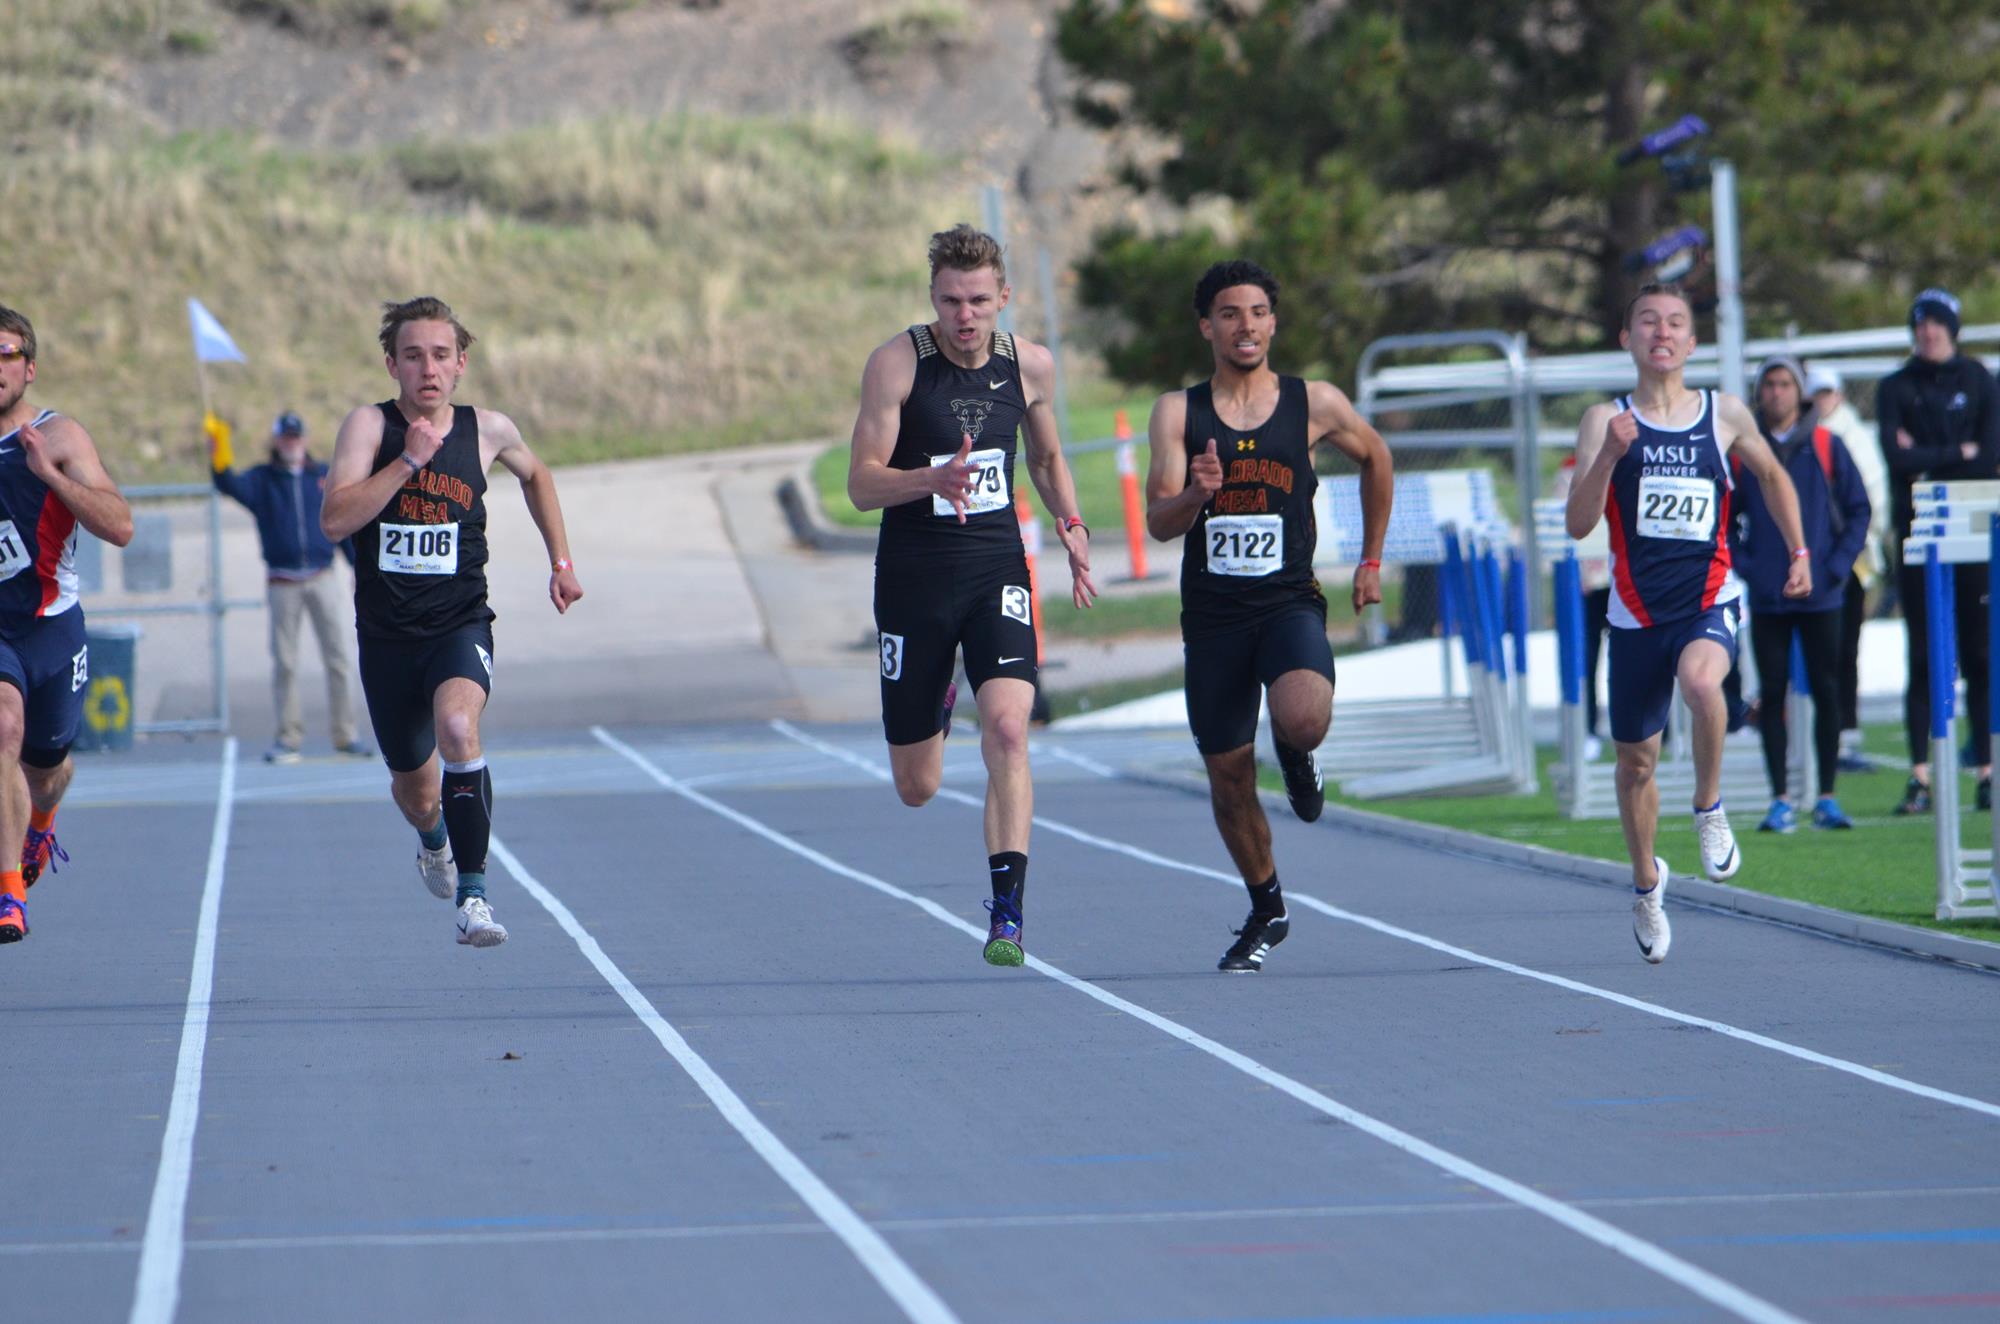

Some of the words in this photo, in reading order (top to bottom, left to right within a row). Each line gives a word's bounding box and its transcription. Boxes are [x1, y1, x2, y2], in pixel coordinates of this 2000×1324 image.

[1643, 445, 1697, 464] MSU
[964, 465, 1000, 494] 79
[1642, 465, 1698, 478] DENVER
[399, 494, 449, 524] MESA
[1214, 488, 1268, 512] MESA
[1644, 493, 1710, 523] 2247
[385, 530, 452, 557] 2106
[1212, 532, 1276, 558] 2122
[1005, 587, 1027, 619] 3
[882, 637, 898, 677] 3
